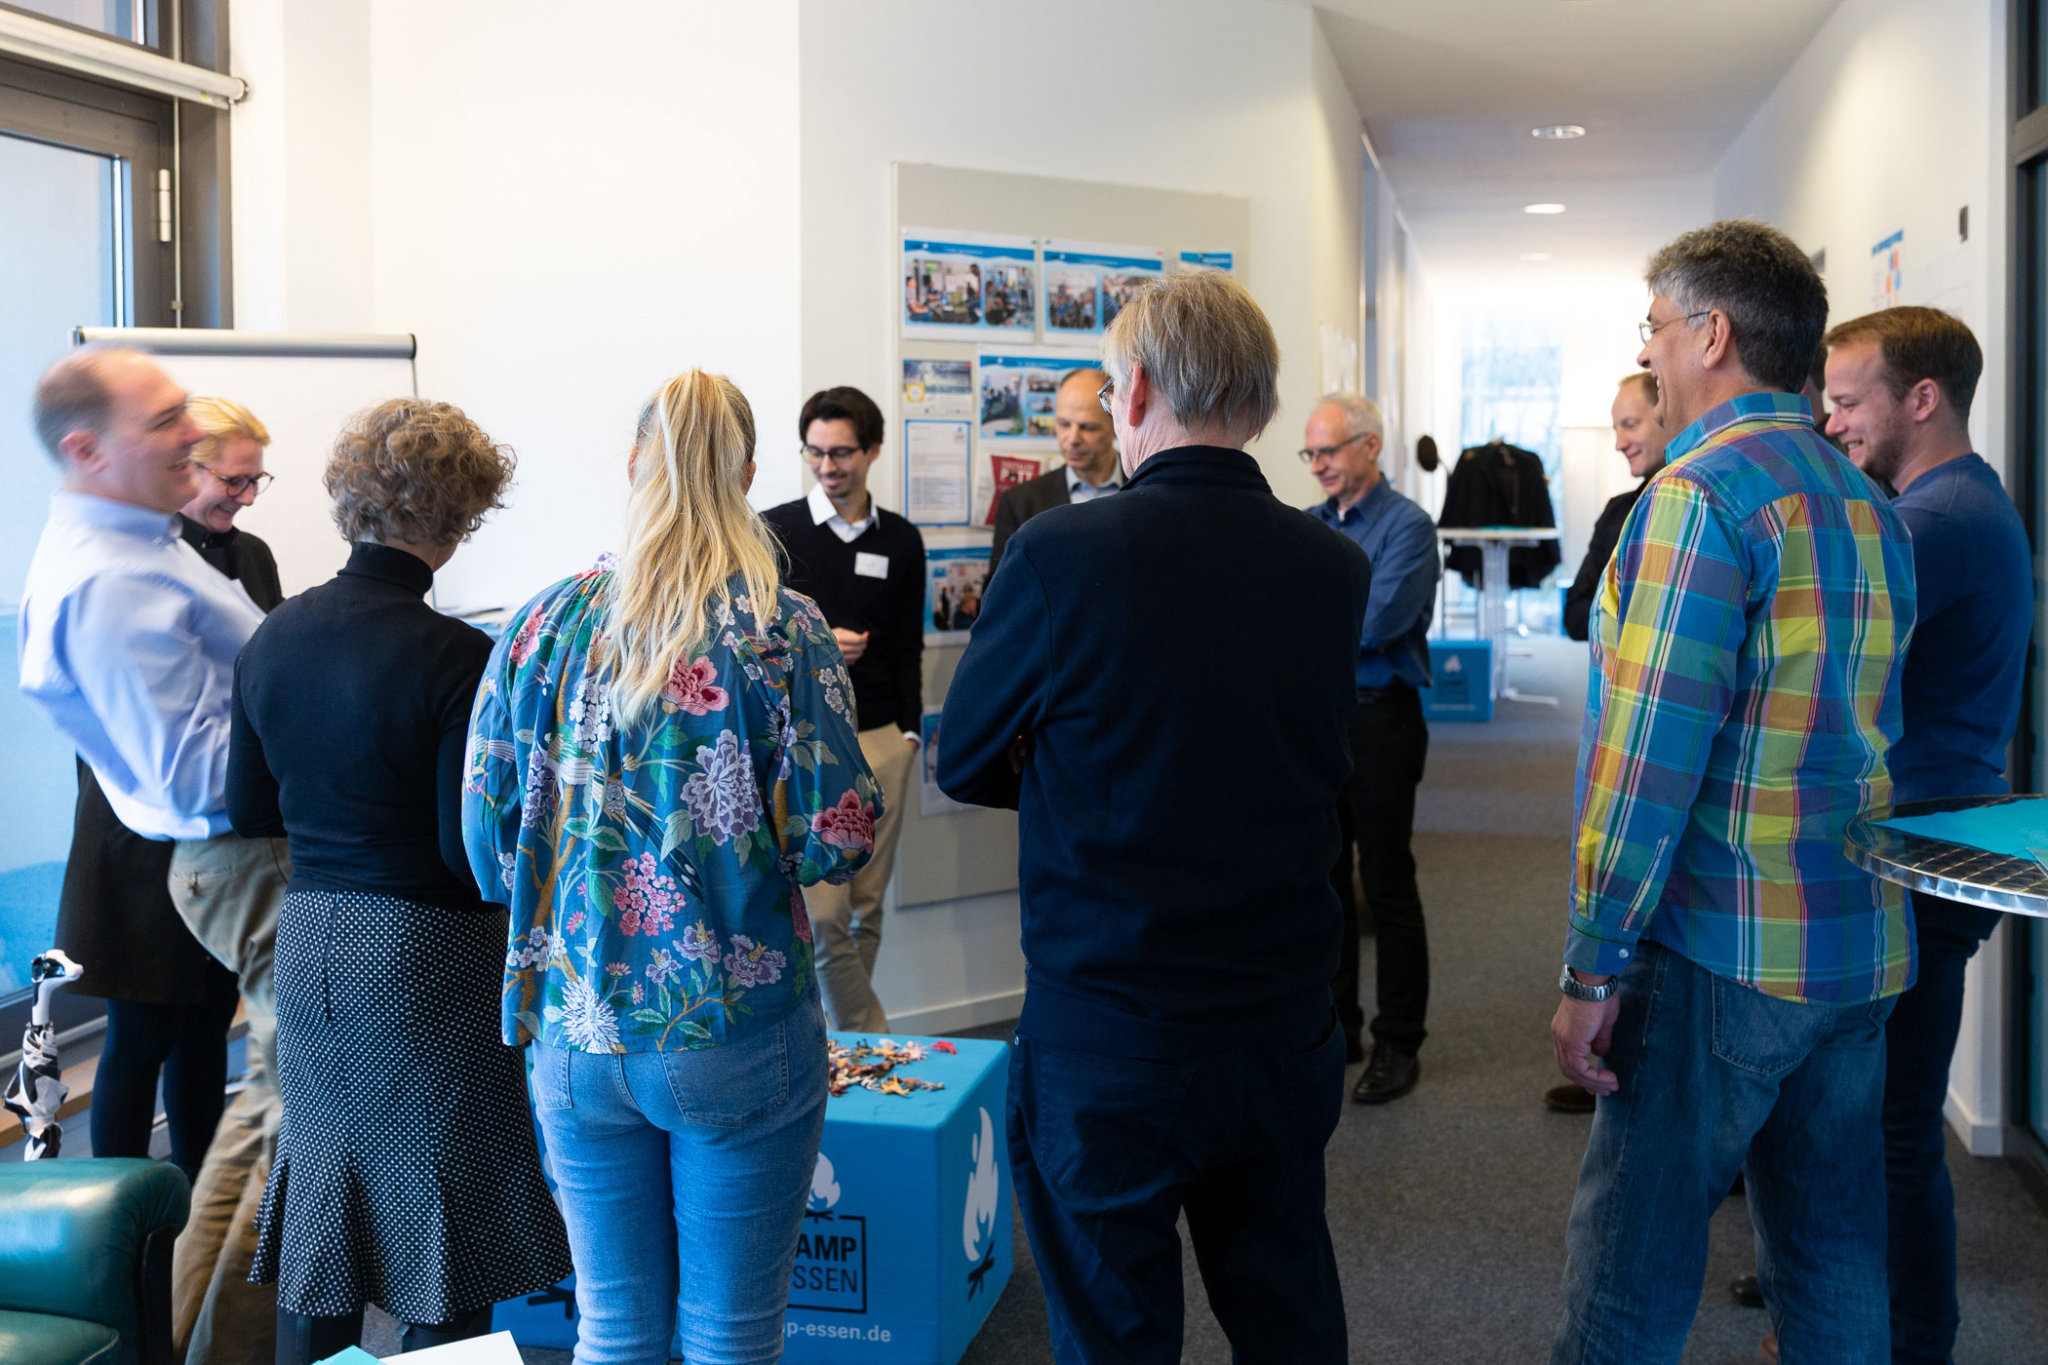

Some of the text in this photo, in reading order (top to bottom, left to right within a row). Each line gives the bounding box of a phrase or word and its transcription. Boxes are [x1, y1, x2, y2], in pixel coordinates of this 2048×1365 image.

[795, 1233, 857, 1262] AMP
[792, 1265, 858, 1293] SSEN
[782, 1321, 892, 1343] p-essen.de
